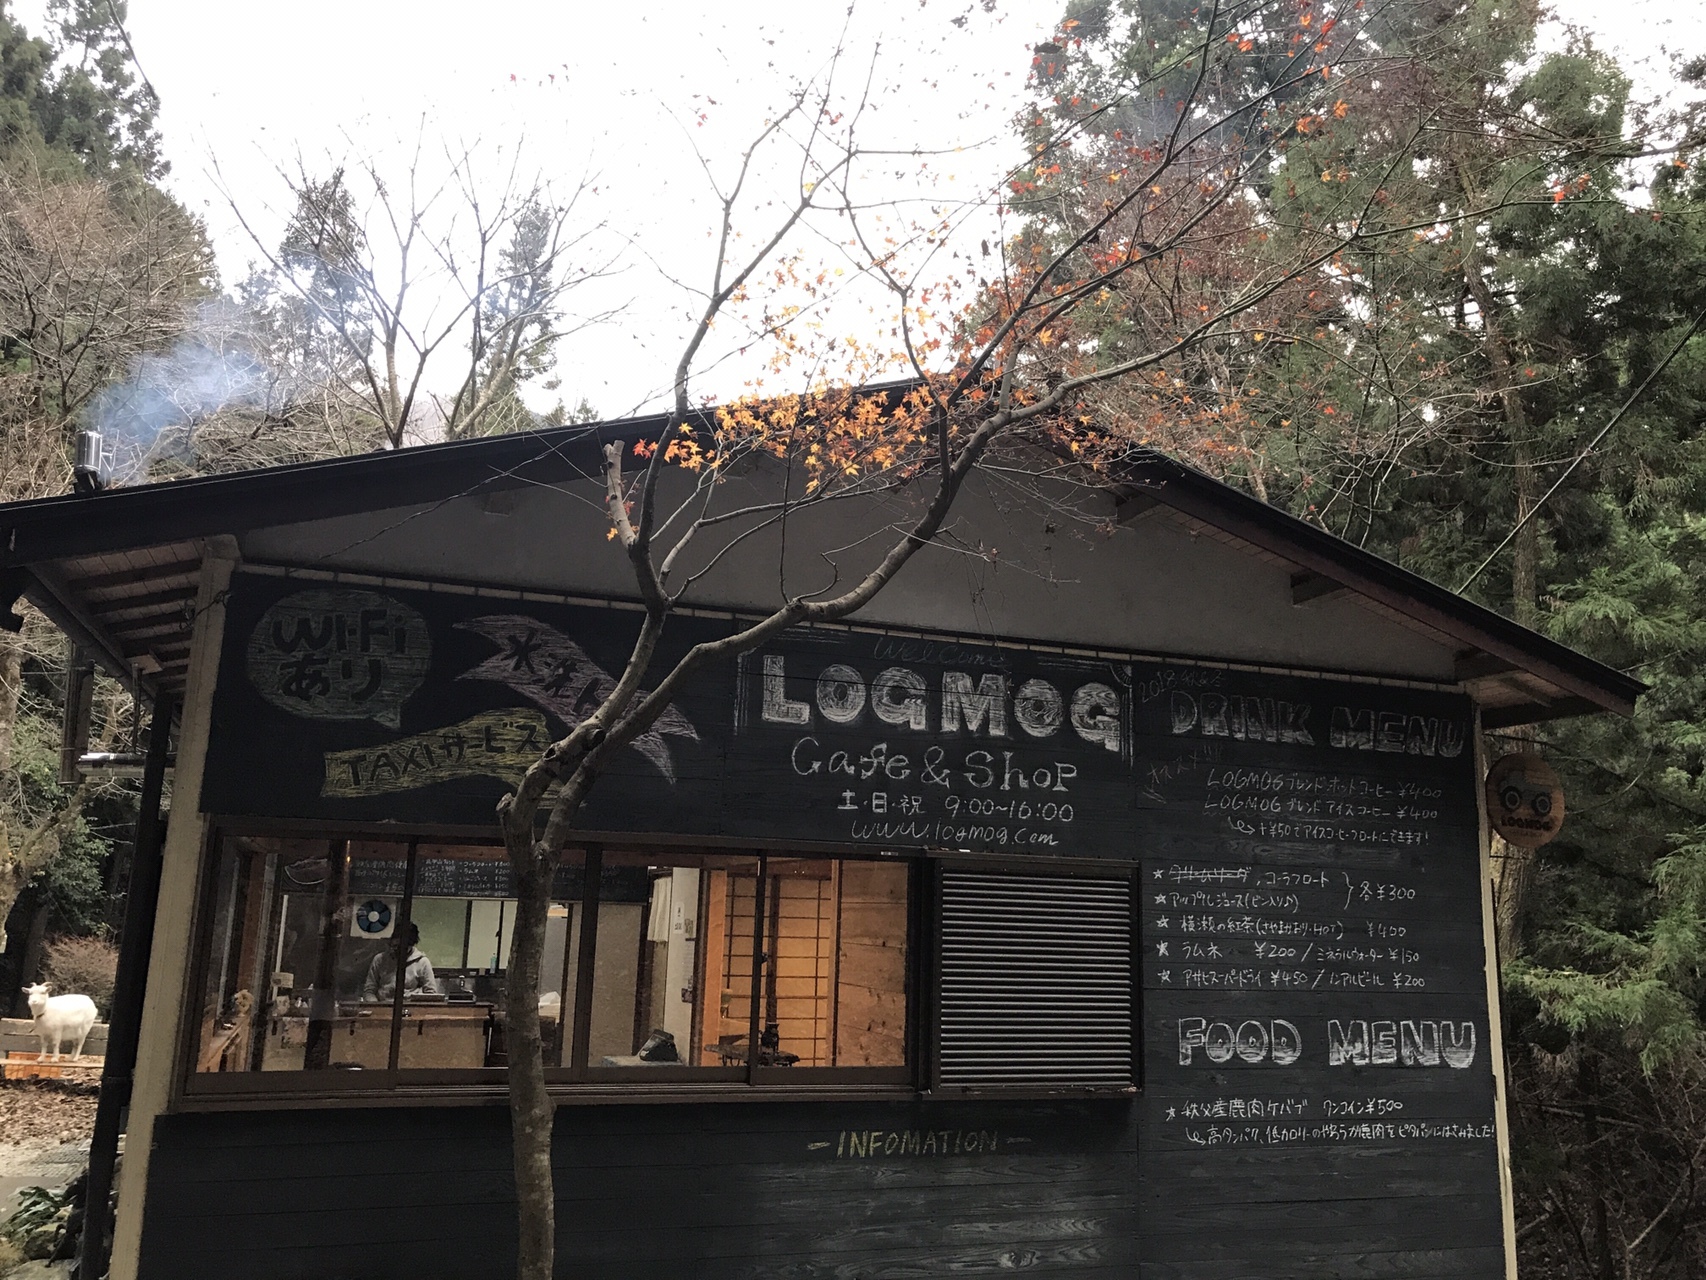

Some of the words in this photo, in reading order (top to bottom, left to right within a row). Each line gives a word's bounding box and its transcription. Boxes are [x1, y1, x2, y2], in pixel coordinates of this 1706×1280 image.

[278, 653, 383, 701] あり
[762, 655, 1121, 752] LOGMOG
[1170, 690, 1316, 747] DRINK
[1330, 706, 1468, 758] MENU
[791, 737, 911, 781] Cafe
[920, 746, 951, 789] &
[1207, 768, 1284, 791] LOGMOG
[1398, 781, 1442, 800] ¥400
[1204, 793, 1282, 812] LOGMOG
[1396, 805, 1438, 820] ¥400
[1366, 921, 1407, 938] ¥400
[1254, 941, 1296, 959] ¥200
[1388, 947, 1420, 964] ¥150
[1270, 969, 1308, 986] ¥450
[1392, 972, 1426, 989] ¥200
[1178, 1017, 1302, 1066] FOOD
[1327, 1019, 1477, 1069] MENU
[836, 1129, 998, 1158] INFOMATION
